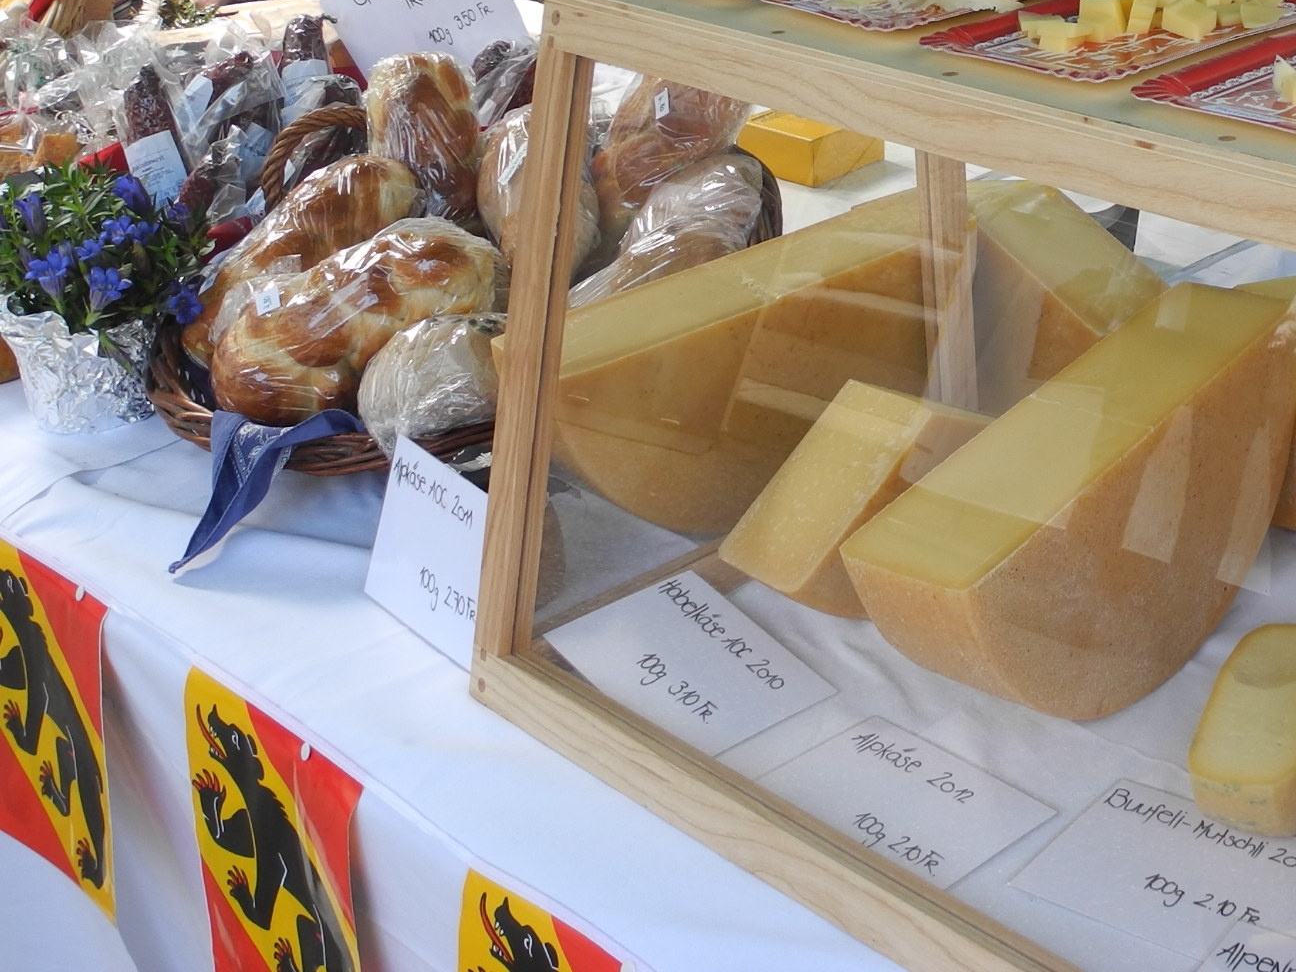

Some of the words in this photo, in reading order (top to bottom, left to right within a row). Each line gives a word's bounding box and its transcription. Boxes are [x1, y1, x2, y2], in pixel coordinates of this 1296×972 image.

[428, 27, 454, 46] 100g
[451, 494, 473, 530] 2011
[420, 566, 439, 611] 100g
[636, 653, 667, 686] 100g
[745, 659, 785, 690] 2010
[926, 771, 975, 805] 2012
[853, 812, 886, 849] 100g
[1144, 873, 1186, 908] 100g
[1193, 893, 1237, 917] 2.10
